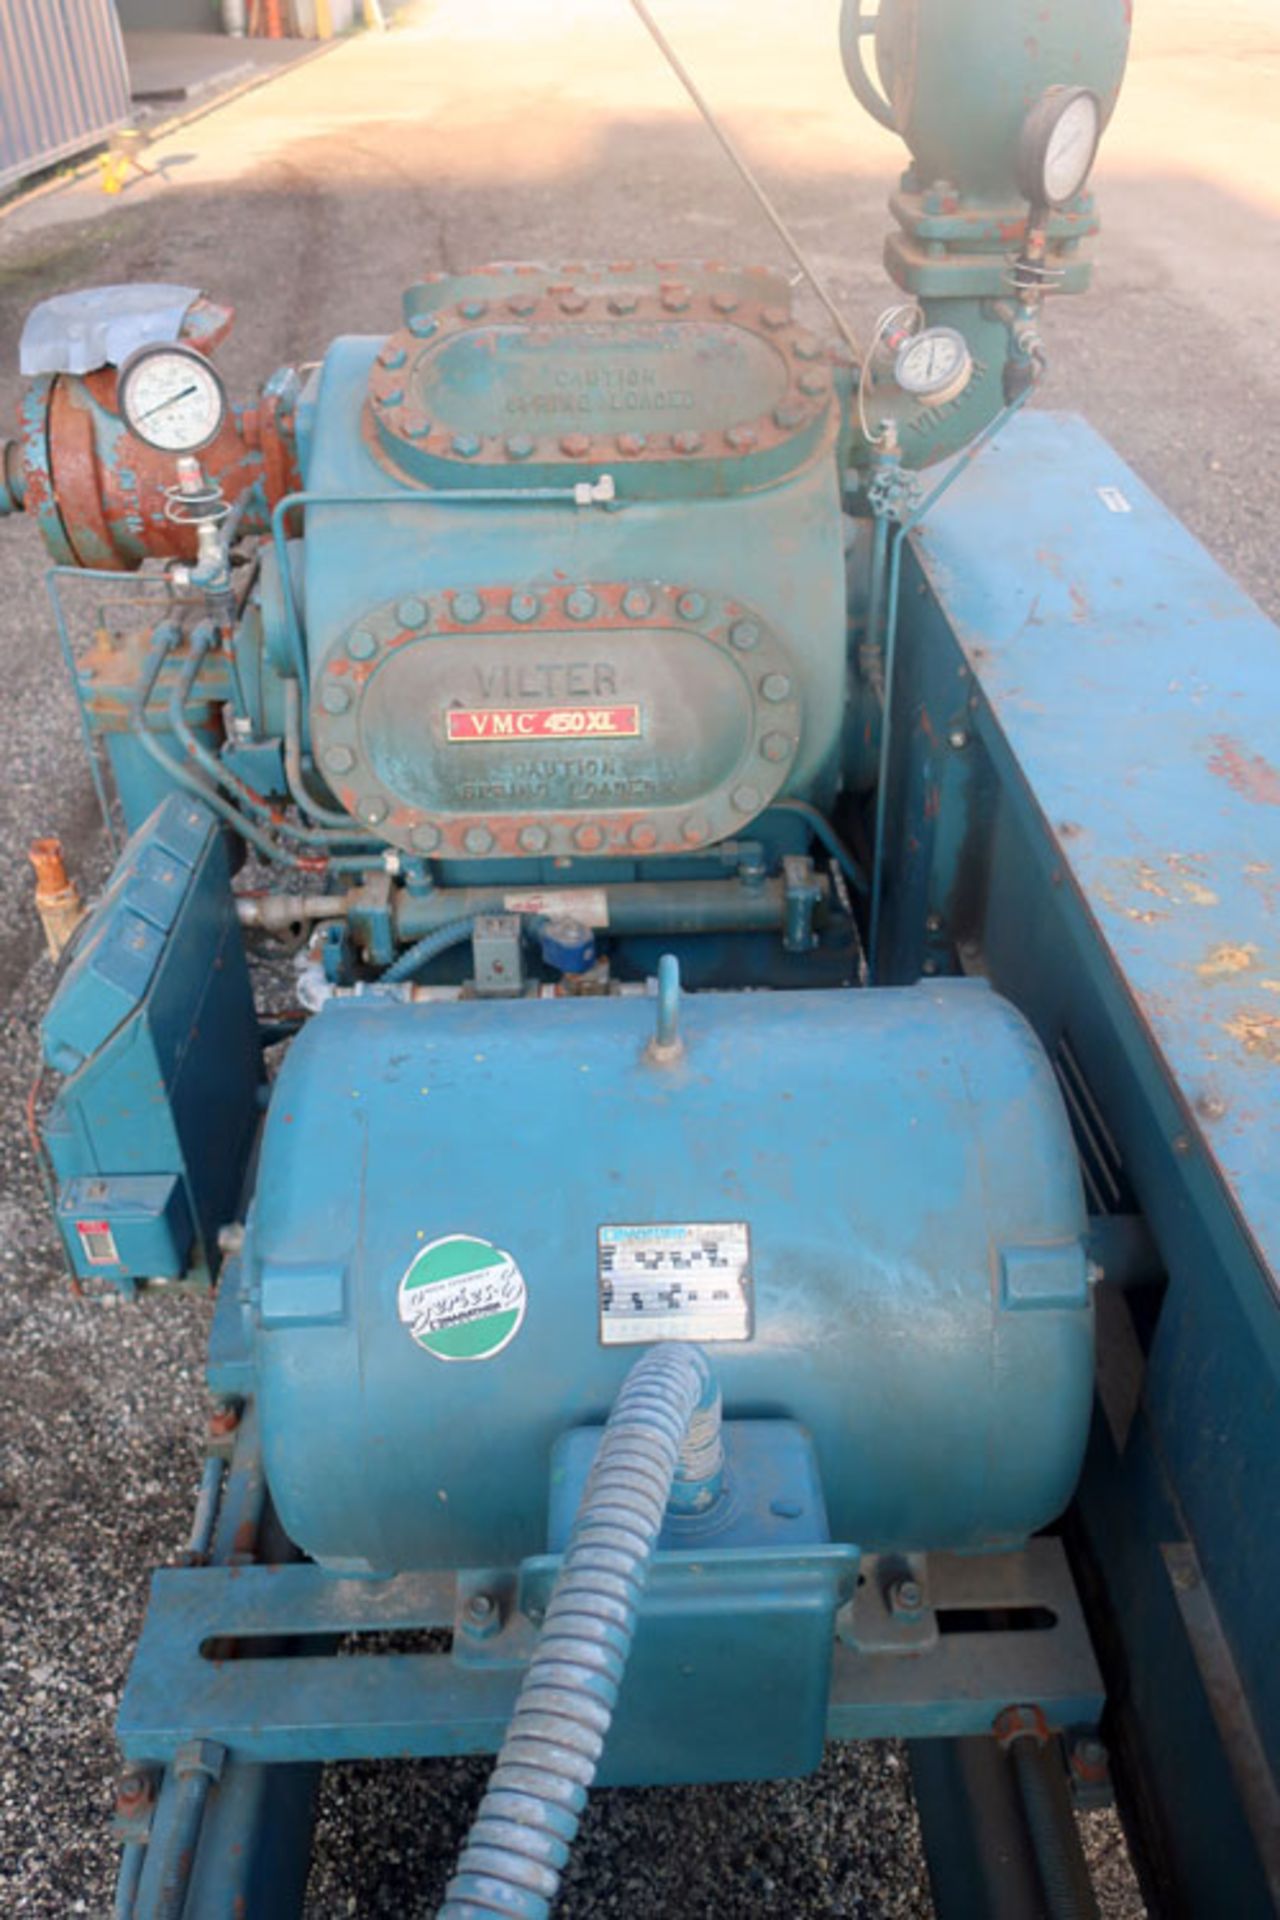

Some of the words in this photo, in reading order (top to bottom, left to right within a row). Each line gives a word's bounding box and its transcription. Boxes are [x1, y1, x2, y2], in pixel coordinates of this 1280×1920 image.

[474, 660, 618, 698] VILTER
[471, 713, 538, 735] VMC
[513, 756, 616, 777] CAUTION
